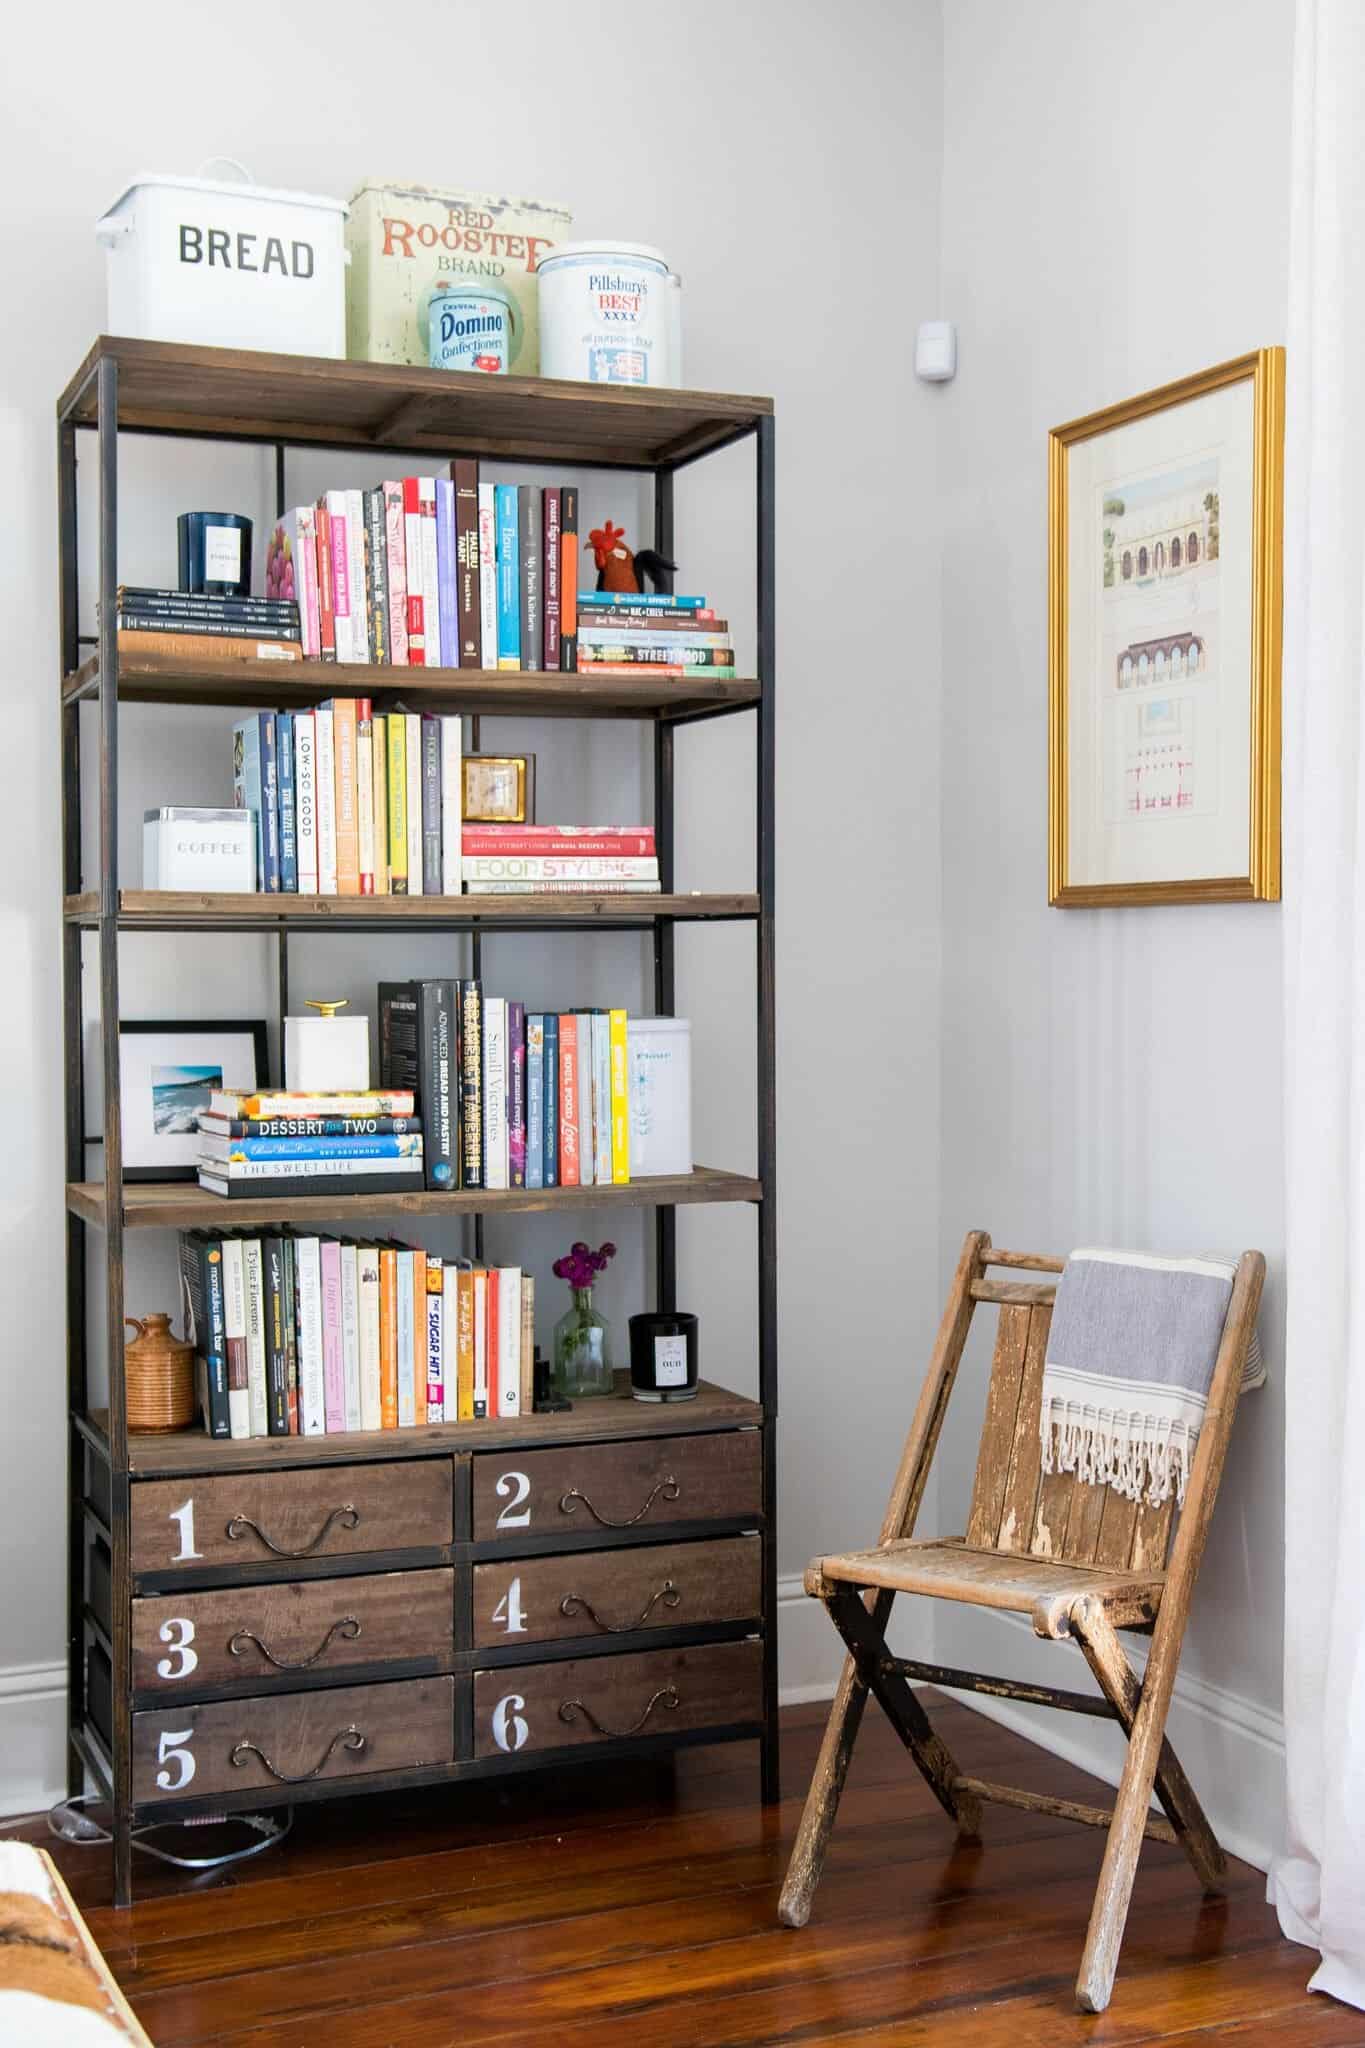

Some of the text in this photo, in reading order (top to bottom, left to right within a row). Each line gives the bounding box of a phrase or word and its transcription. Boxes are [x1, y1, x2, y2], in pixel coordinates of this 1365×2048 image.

[448, 208, 494, 230] RED
[178, 224, 314, 279] BREAD
[438, 255, 505, 277] BRAND
[589, 273, 648, 297] Pillsbury's
[598, 294, 641, 312] BEST
[440, 312, 503, 343] Domino
[602, 311, 637, 322] XXXX
[457, 535, 466, 564] FARM
[470, 530, 479, 569] MALIBU
[527, 595, 538, 633] Kitchen
[300, 735, 313, 837] LOW-SO GOOD
[176, 841, 242, 856] COFFEE
[439, 1009, 449, 1059] ADVANCED
[439, 1059, 449, 1094] BREAD
[487, 1031, 504, 1145] Small Victories
[440, 1094, 450, 1117] AND
[563, 1086, 574, 1119] FOOD
[259, 1120, 325, 1136] DESSERT
[343, 1119, 377, 1134] TWO
[440, 1117, 450, 1157] PASTRY
[241, 1160, 353, 1176] THE SWEET LIFE
[247, 1248, 260, 1335] Tyler Florence
[213, 1335, 224, 1353] bar
[429, 1312, 441, 1353] SUGAR
[495, 1471, 532, 1529] 2
[169, 1498, 204, 1562] 1
[491, 1576, 529, 1634] 4
[156, 1617, 199, 1679] 3
[491, 1694, 530, 1753] 6
[155, 1728, 197, 1790] 5
